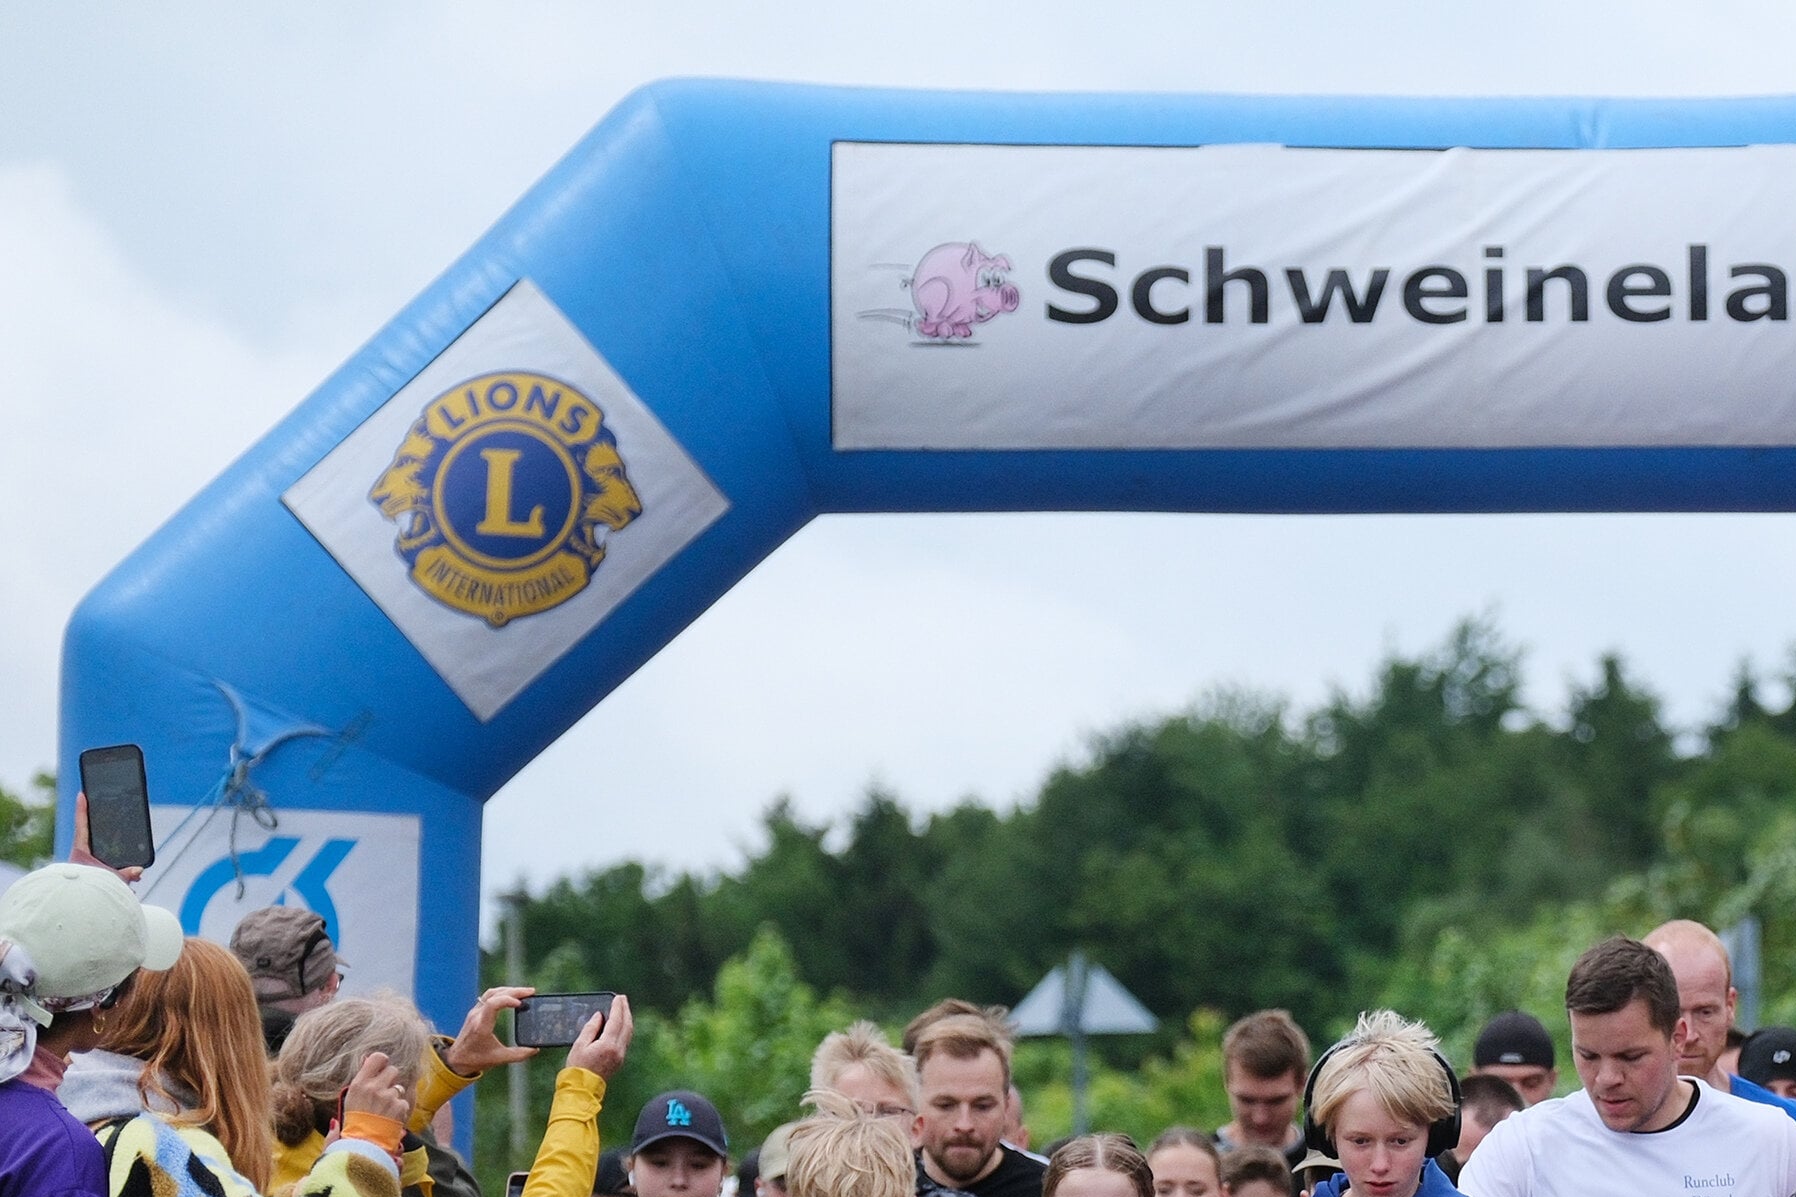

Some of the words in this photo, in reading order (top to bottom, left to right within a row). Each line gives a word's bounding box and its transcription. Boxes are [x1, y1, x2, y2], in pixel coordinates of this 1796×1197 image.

[440, 382, 589, 435] LIONS
[476, 449, 545, 539] L
[426, 557, 576, 606] INTERNATIONAL
[666, 1099, 692, 1126] LA
[1684, 1173, 1735, 1188] Runclub
